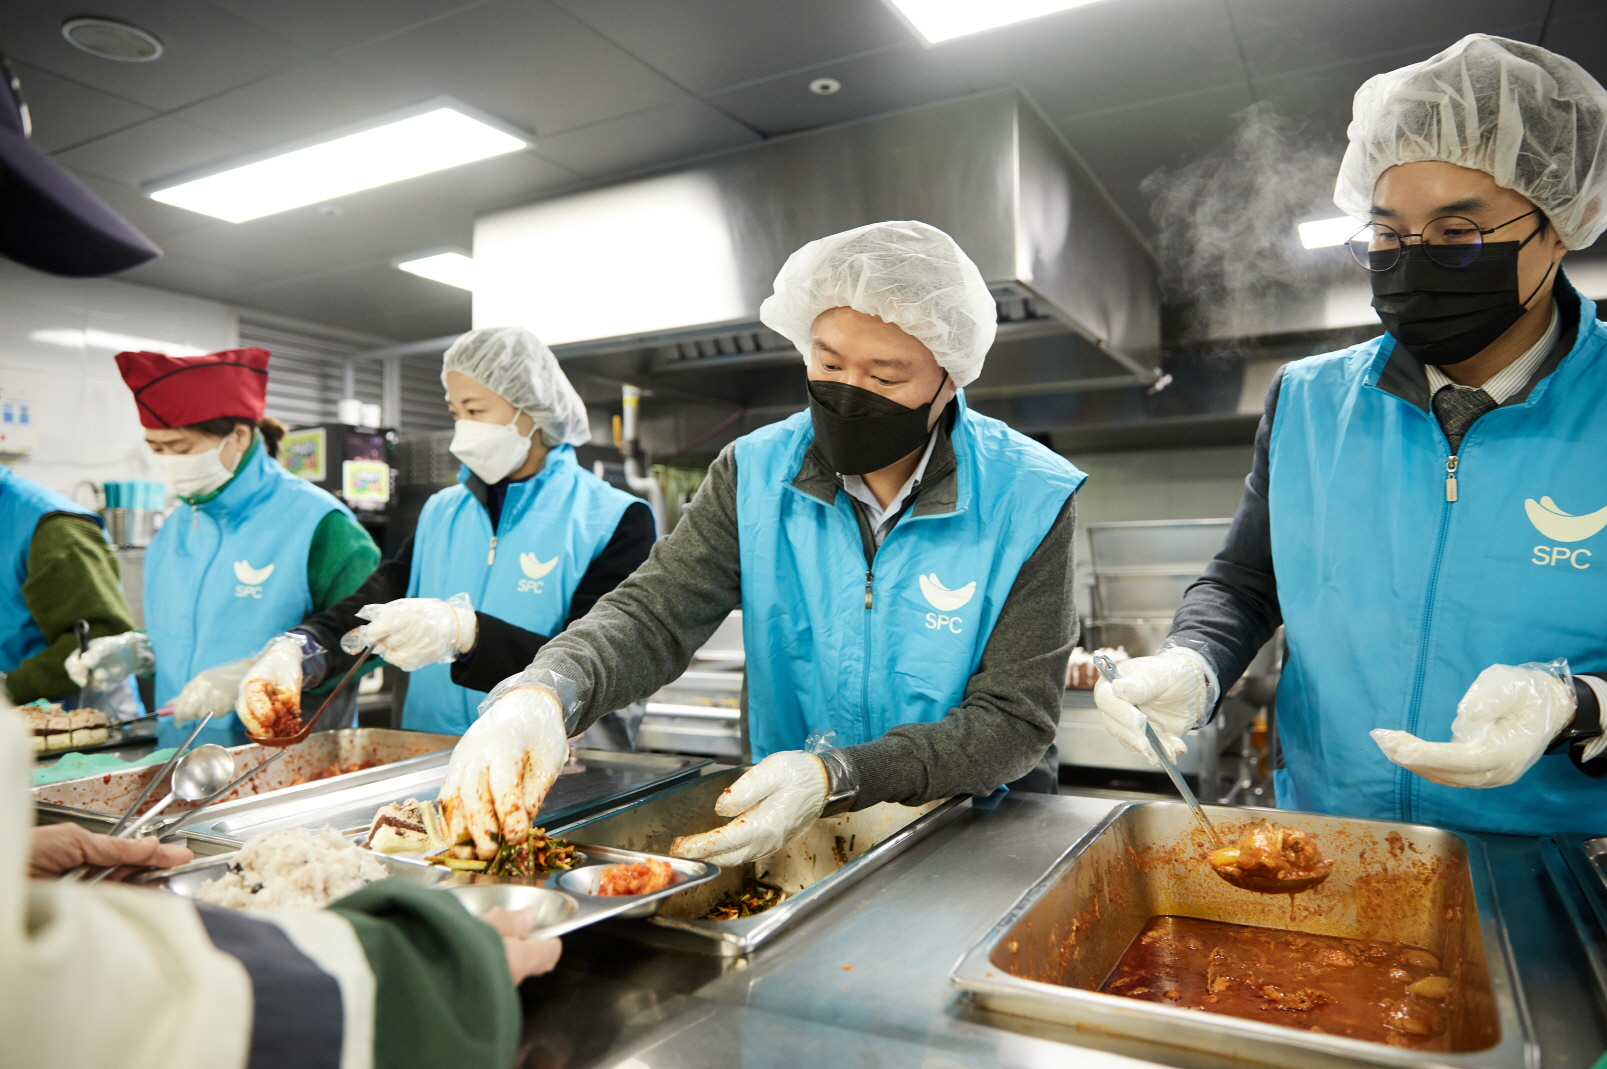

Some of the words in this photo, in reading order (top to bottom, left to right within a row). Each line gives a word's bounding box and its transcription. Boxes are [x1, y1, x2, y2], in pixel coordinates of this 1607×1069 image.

[1531, 545, 1592, 569] SPC
[234, 584, 263, 599] SPC
[517, 579, 544, 594] SPC
[925, 613, 963, 633] SPC
